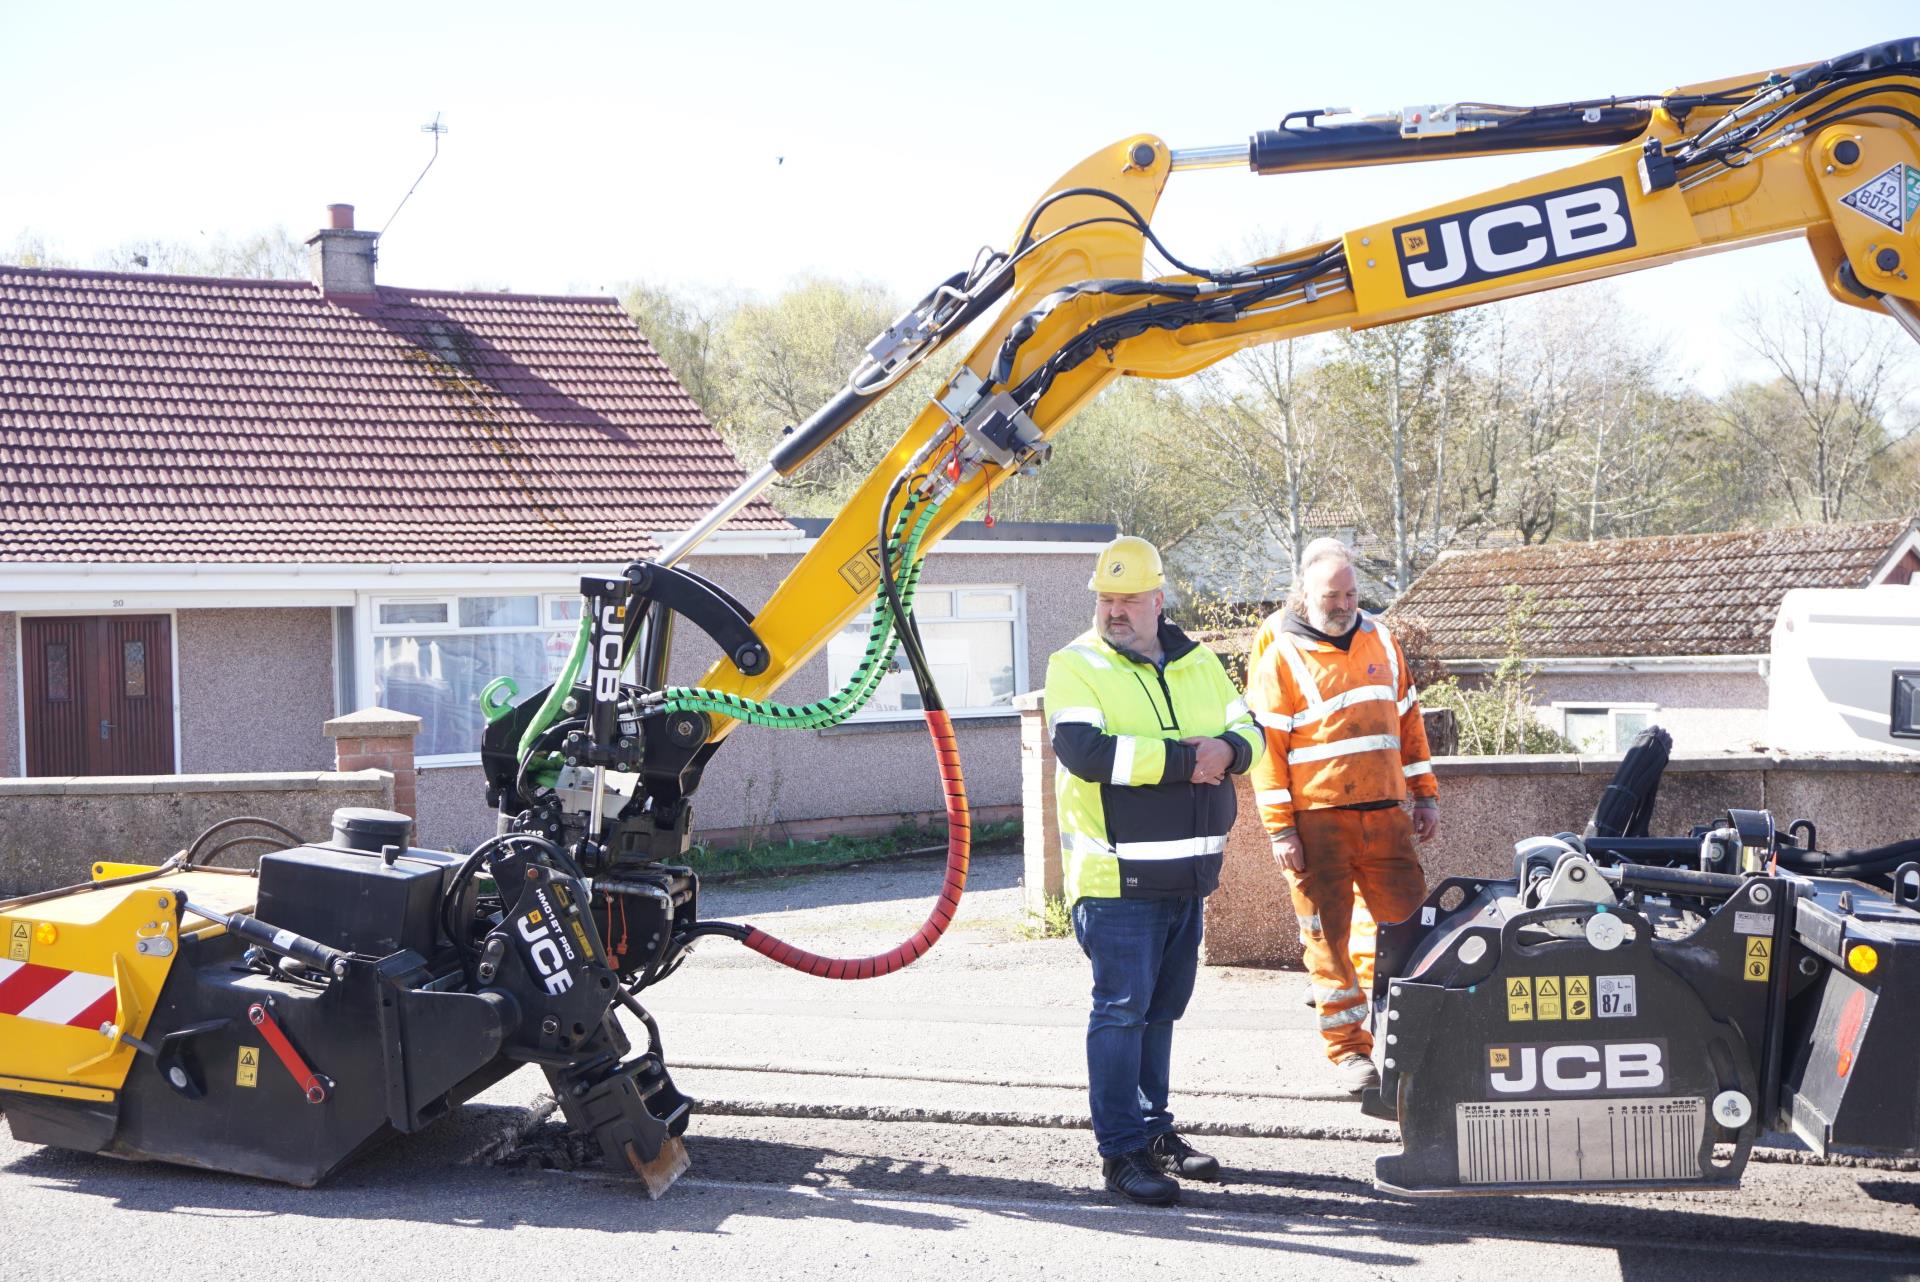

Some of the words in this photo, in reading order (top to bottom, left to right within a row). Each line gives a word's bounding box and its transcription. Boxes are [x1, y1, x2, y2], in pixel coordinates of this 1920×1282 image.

[1875, 181, 1897, 199] 19
[1407, 187, 1628, 288] JCB
[112, 599, 124, 608] 20
[596, 605, 625, 702] JCB
[558, 935, 575, 961] PRO
[1602, 993, 1620, 1013] 87
[1490, 1042, 1664, 1093] JCB
